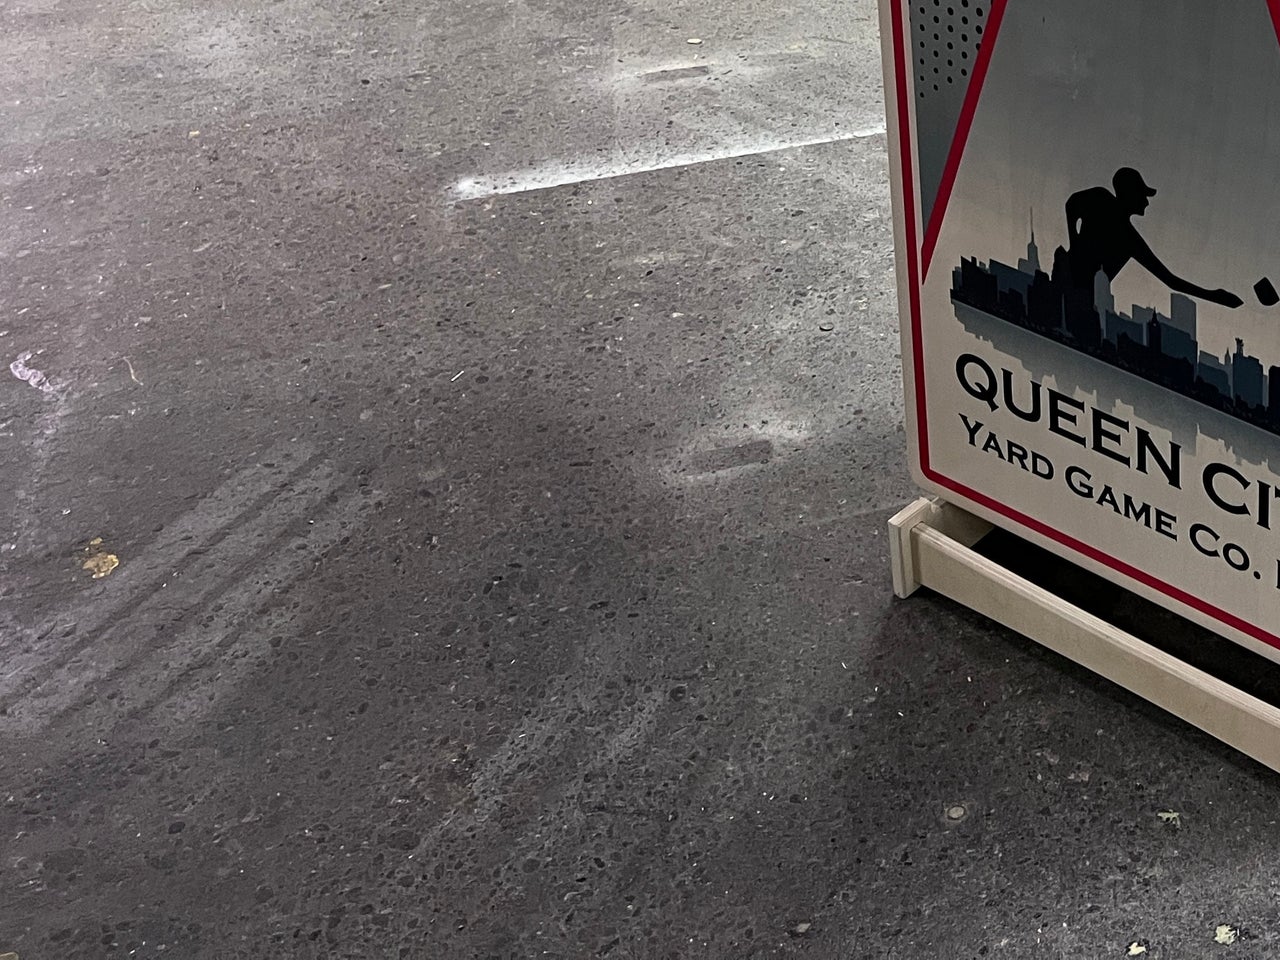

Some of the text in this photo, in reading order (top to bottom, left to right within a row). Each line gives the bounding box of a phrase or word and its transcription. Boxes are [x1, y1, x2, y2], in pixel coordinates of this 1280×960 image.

[955, 353, 1182, 490] QUEEN
[957, 413, 1054, 480] YARD
[1065, 465, 1179, 542] GAME
